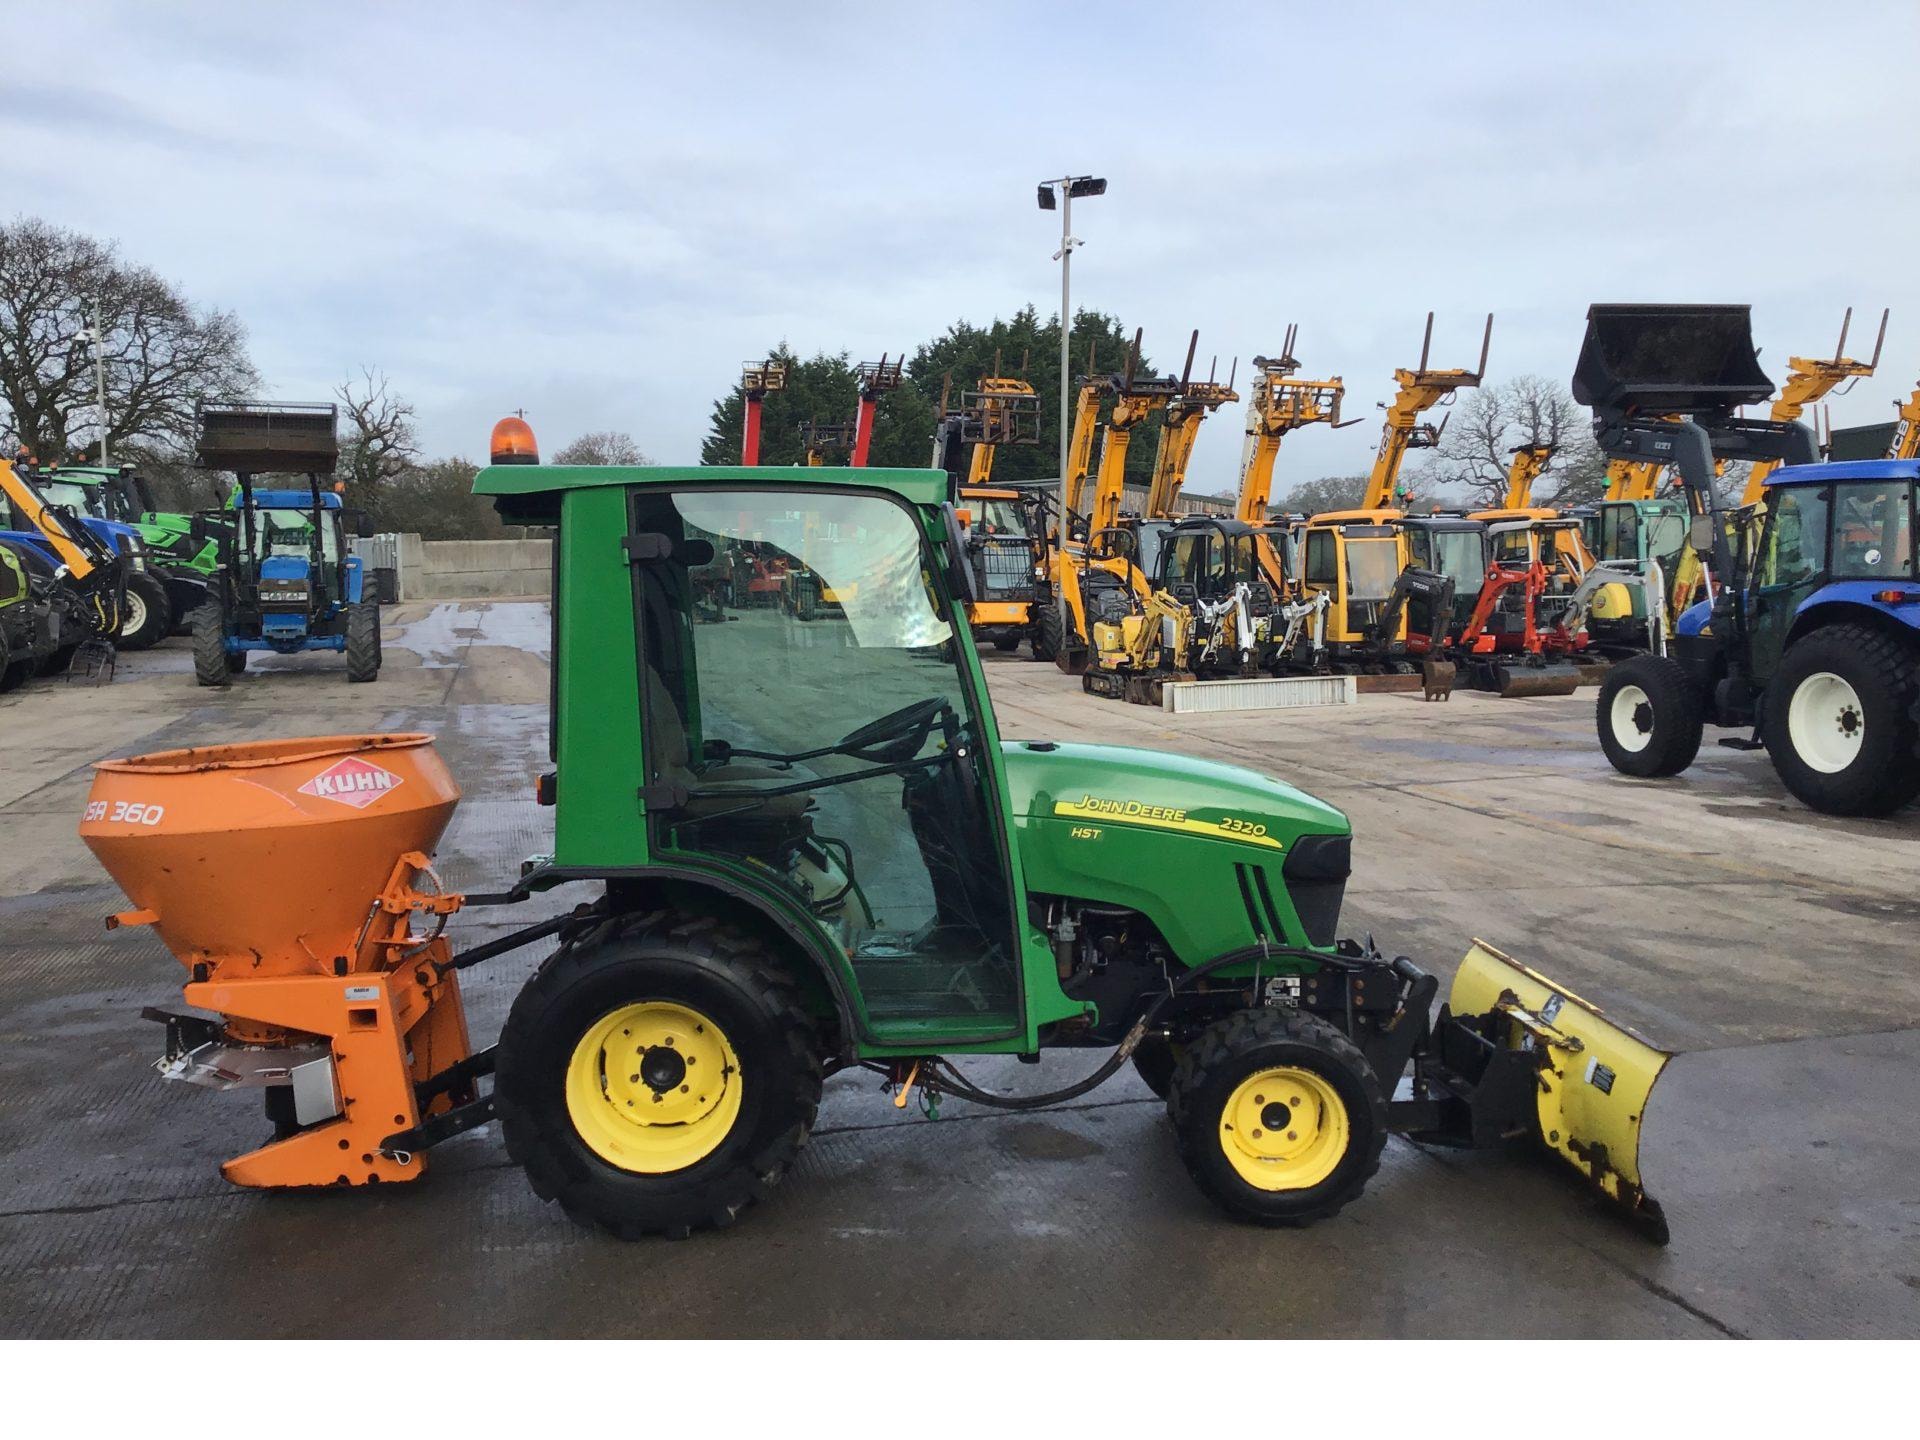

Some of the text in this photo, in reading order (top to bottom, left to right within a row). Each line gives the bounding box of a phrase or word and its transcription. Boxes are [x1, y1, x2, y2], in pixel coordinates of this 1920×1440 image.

[314, 771, 394, 796] KUHN
[110, 801, 164, 826] 360
[1073, 794, 1267, 837] JOHN DEERE 2320
[1070, 826, 1102, 840] HST
